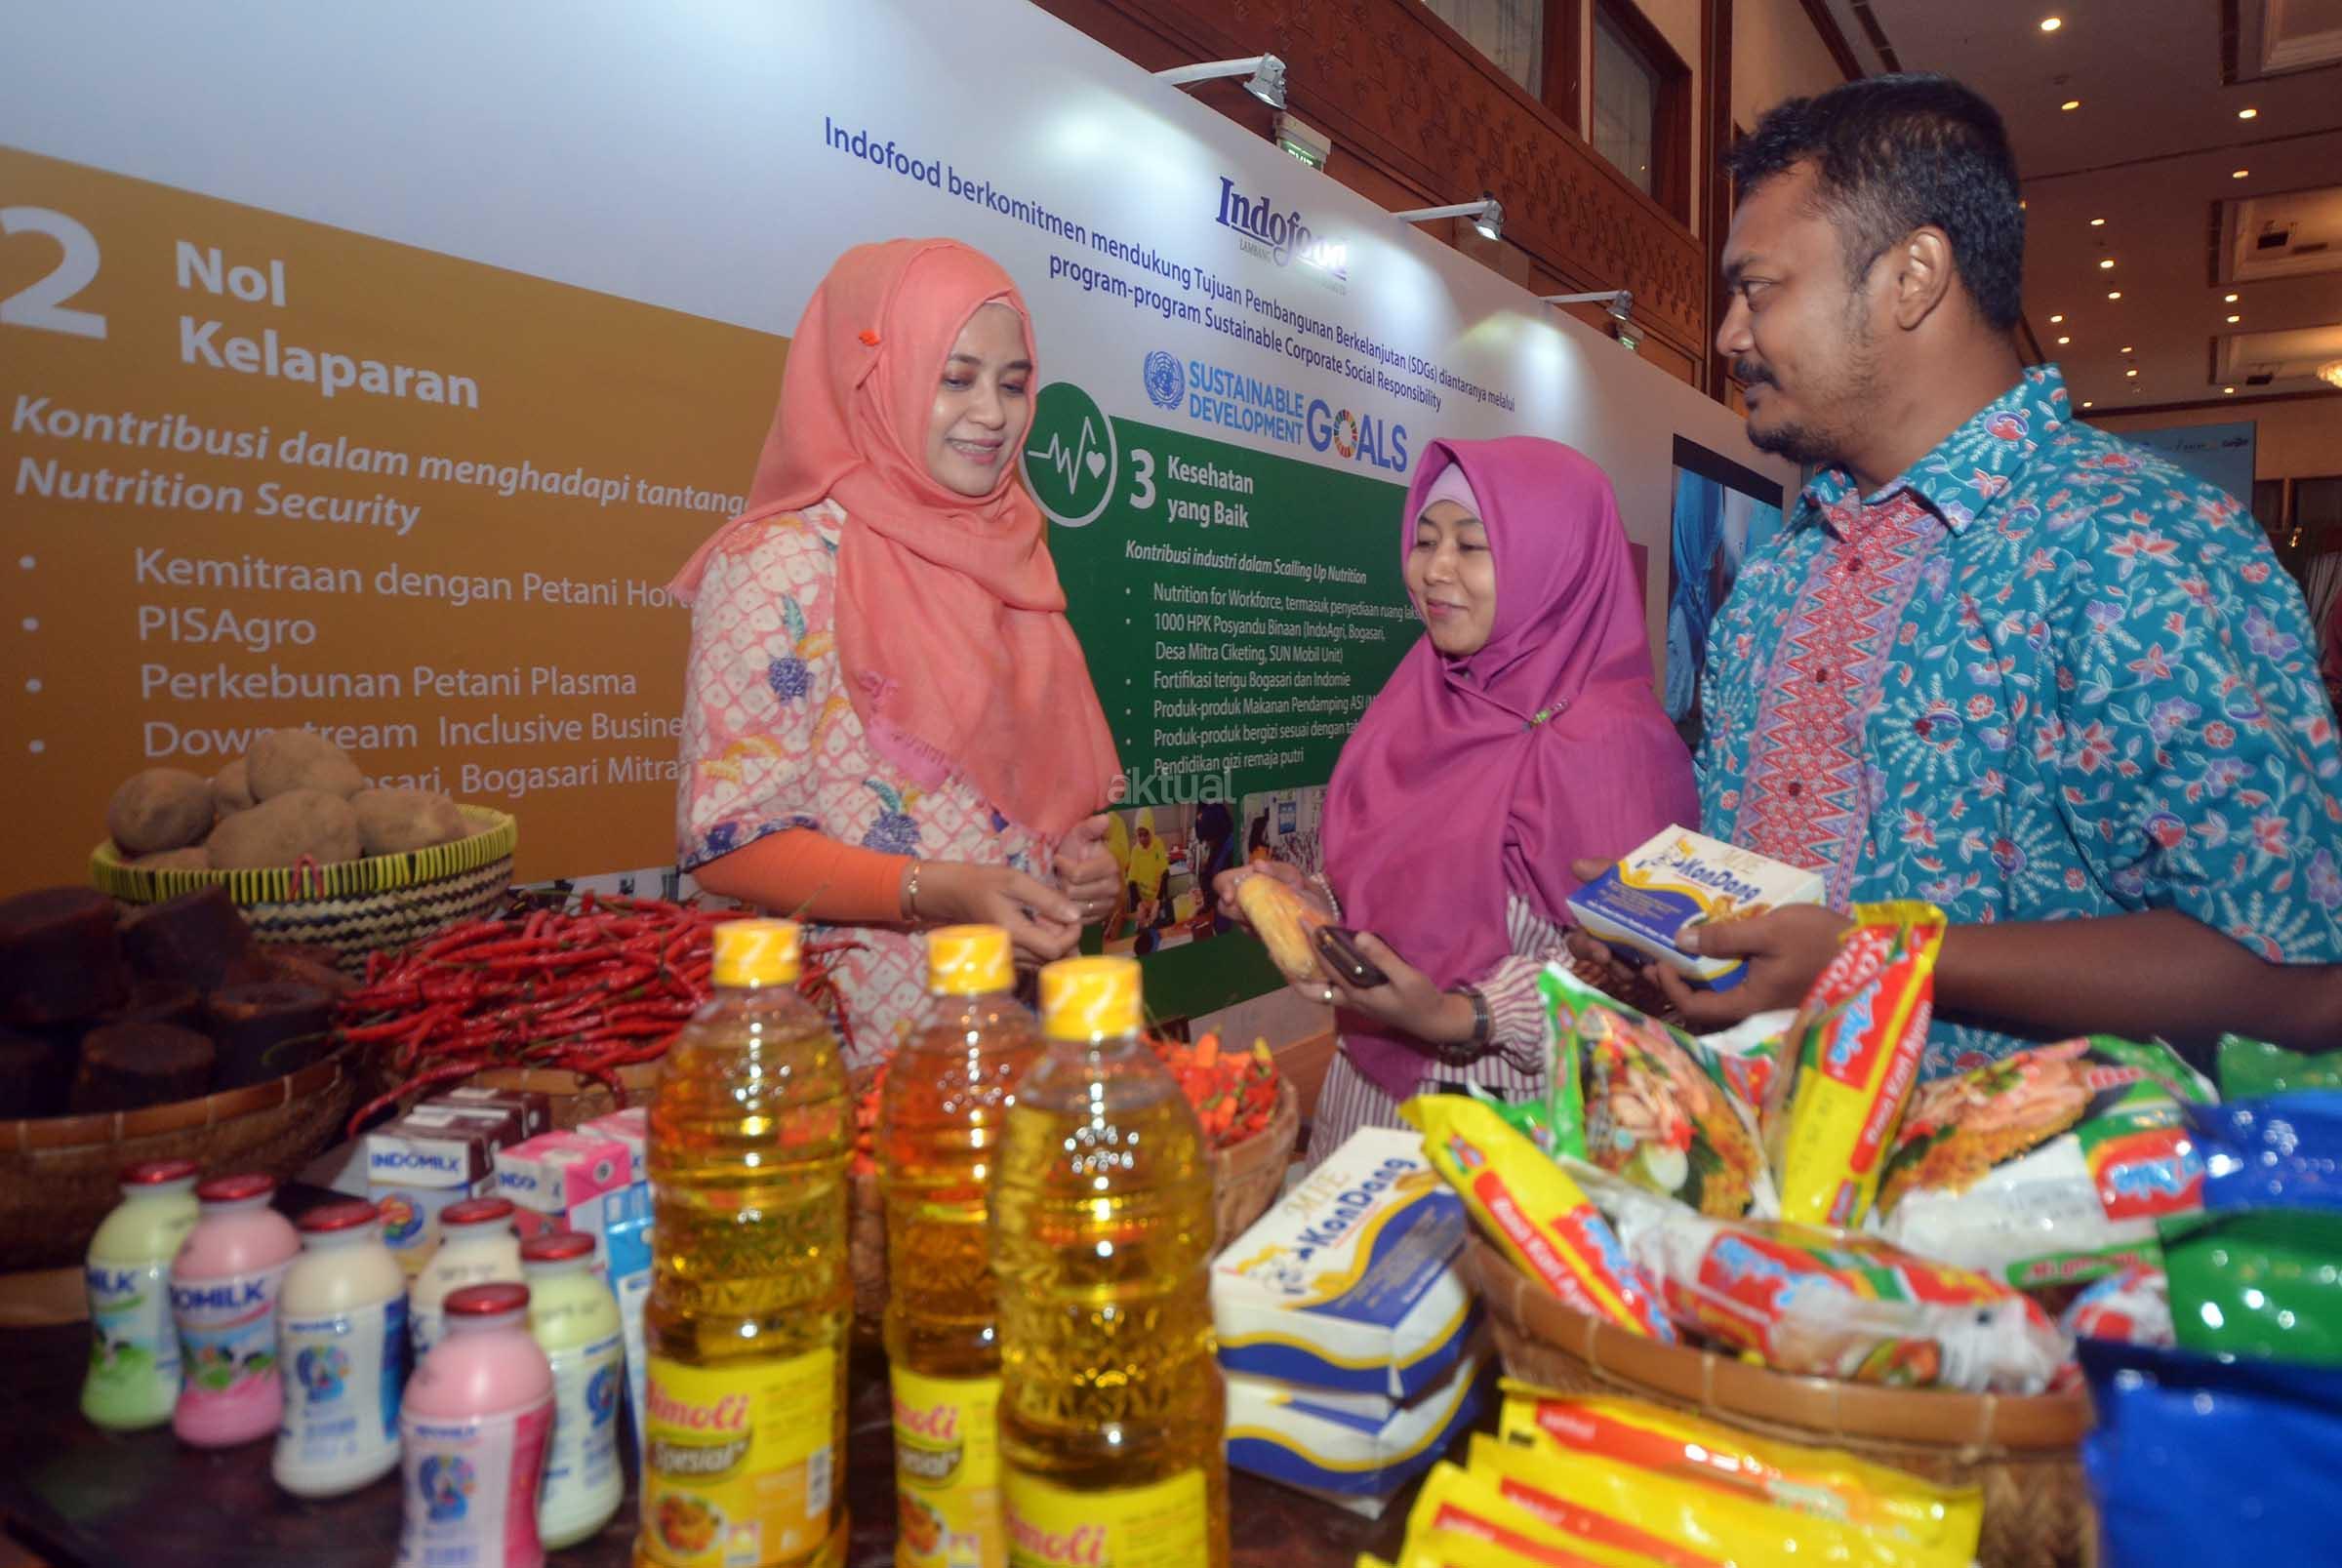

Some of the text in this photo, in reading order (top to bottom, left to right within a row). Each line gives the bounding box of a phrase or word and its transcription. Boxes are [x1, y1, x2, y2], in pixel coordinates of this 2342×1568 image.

[0, 206, 107, 340] 2
[176, 241, 286, 306] Nol
[825, 116, 1515, 413] Indofood berkomitmen mendukung Tujuan Pembangunan Berkelanjutan (SDGs) diantaranya melalui
[1049, 252, 1442, 413] program-program Sustainable Corporate Social Responsibility
[180, 315, 480, 409] Kelaparan
[1189, 360, 1407, 473] SUSTAINABLE GOALS
[1189, 394, 1304, 446] DEVELOPMENT
[12, 394, 749, 521] Kontribusi dalam menghadapi tantang
[1128, 448, 1156, 509] 3
[1167, 455, 1254, 495] Kesehatan
[15, 457, 422, 536] Nutrition Security
[1167, 498, 1250, 529] yang Baik
[135, 547, 362, 595] Kemitraan
[375, 563, 513, 611] dengan
[522, 572, 619, 606] Petani
[1125, 539, 1367, 584] Kontribusi industri dalam Scalling Up Nutrition
[1154, 583, 1208, 604] Nutrition
[1210, 585, 1228, 605] for
[1228, 588, 1284, 611] Workforce,
[1285, 594, 1329, 612] termasuk
[1329, 601, 1380, 619] penyediaan
[1380, 605, 1404, 623] ruang
[138, 606, 317, 652] PISAgro
[1154, 613, 1186, 632] 1000
[1187, 615, 1212, 633] HPK
[1213, 616, 1267, 638] Posyandu
[1268, 620, 1302, 637] Binaan
[1155, 641, 1187, 662] Desa
[1188, 643, 1219, 662] Mitra
[1221, 643, 1268, 665] Ciketing,
[1269, 646, 1292, 663] SUN
[1293, 645, 1319, 663] Mobil
[141, 663, 637, 701] Perkebunan Petani Plasma
[1153, 670, 1352, 693] Fortifikasi terigu Bogasari dan Indomie
[1153, 697, 1241, 720] Produk-produk
[1243, 697, 1290, 715] Makanan
[1291, 694, 1350, 716] Pendamping
[1350, 694, 1365, 711] ASI
[144, 720, 419, 758] Dowream
[439, 716, 583, 747] Inclusive
[1153, 727, 1241, 750] Produk-produk
[1242, 724, 1279, 744] bergizi
[1279, 721, 1310, 740] sesuai
[1310, 720, 1346, 740] dengan
[462, 759, 598, 798] Bogasari
[1154, 746, 1305, 777] Pendidikan gizi remaja putri
[371, 1153, 461, 1175] INDOMILK
